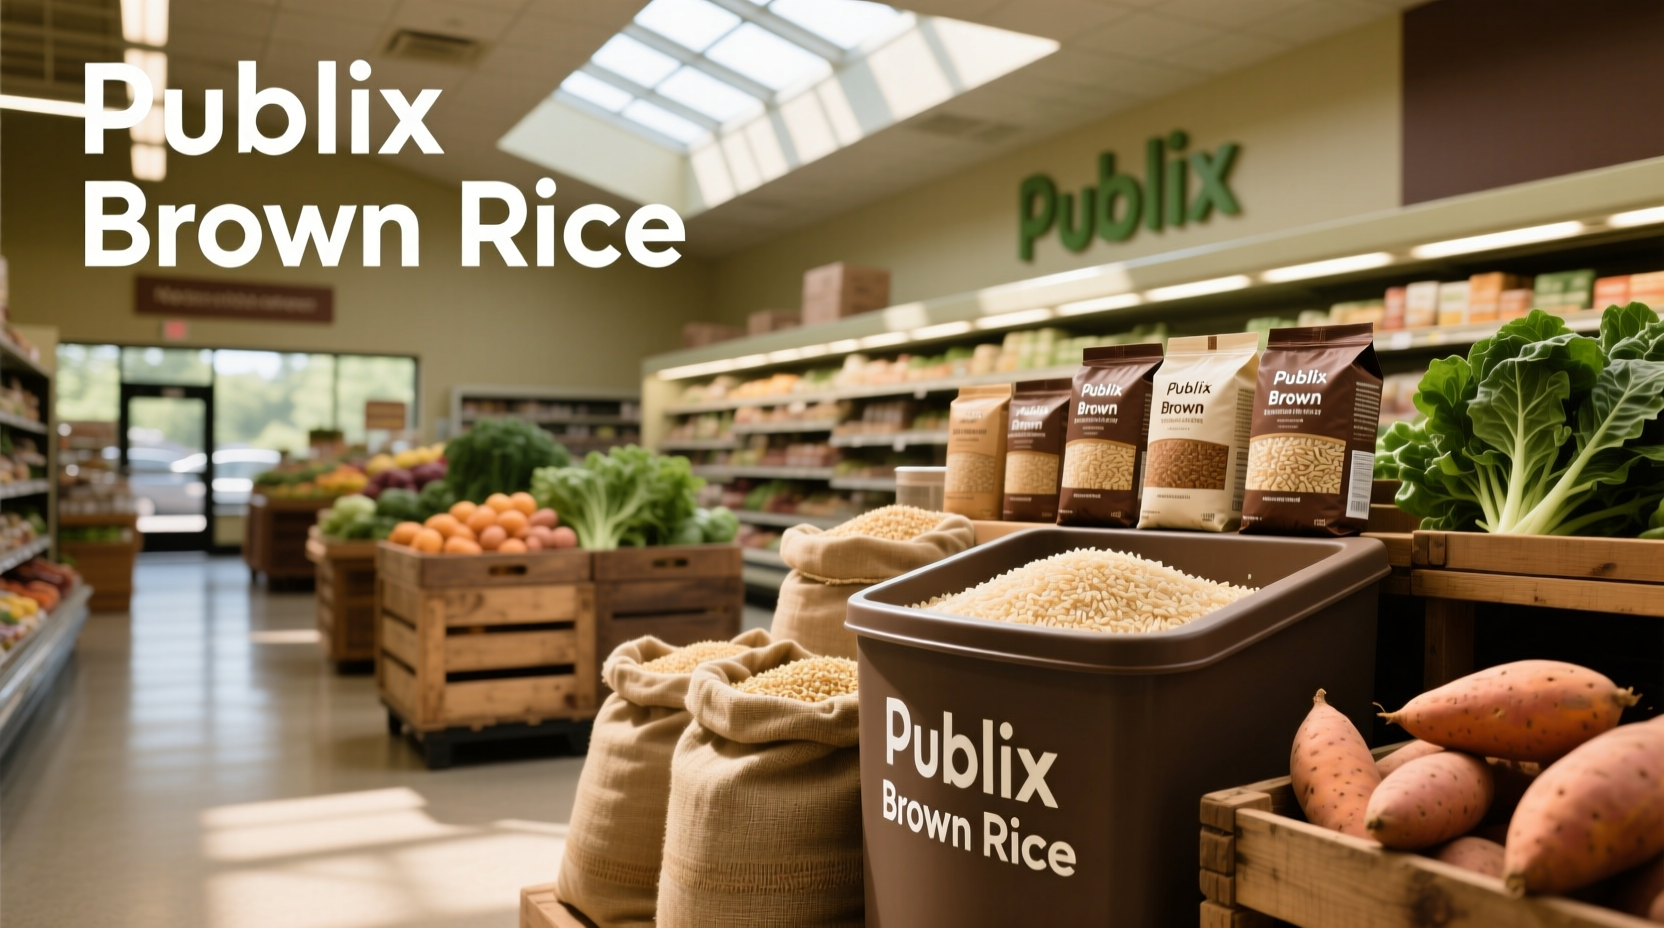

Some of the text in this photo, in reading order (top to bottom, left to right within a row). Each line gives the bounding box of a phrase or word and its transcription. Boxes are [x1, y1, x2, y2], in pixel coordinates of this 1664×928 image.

[1019, 129, 1241, 261] Publix
[1273, 369, 1328, 386] Publix
[1081, 383, 1123, 398] Publix
[1166, 380, 1213, 396] Publix
[1268, 389, 1322, 406] Brown
[1077, 401, 1119, 416] Brown
[1160, 401, 1205, 415] Brown
[886, 696, 1059, 809] Publix
[882, 778, 1077, 877] Brown Rice
